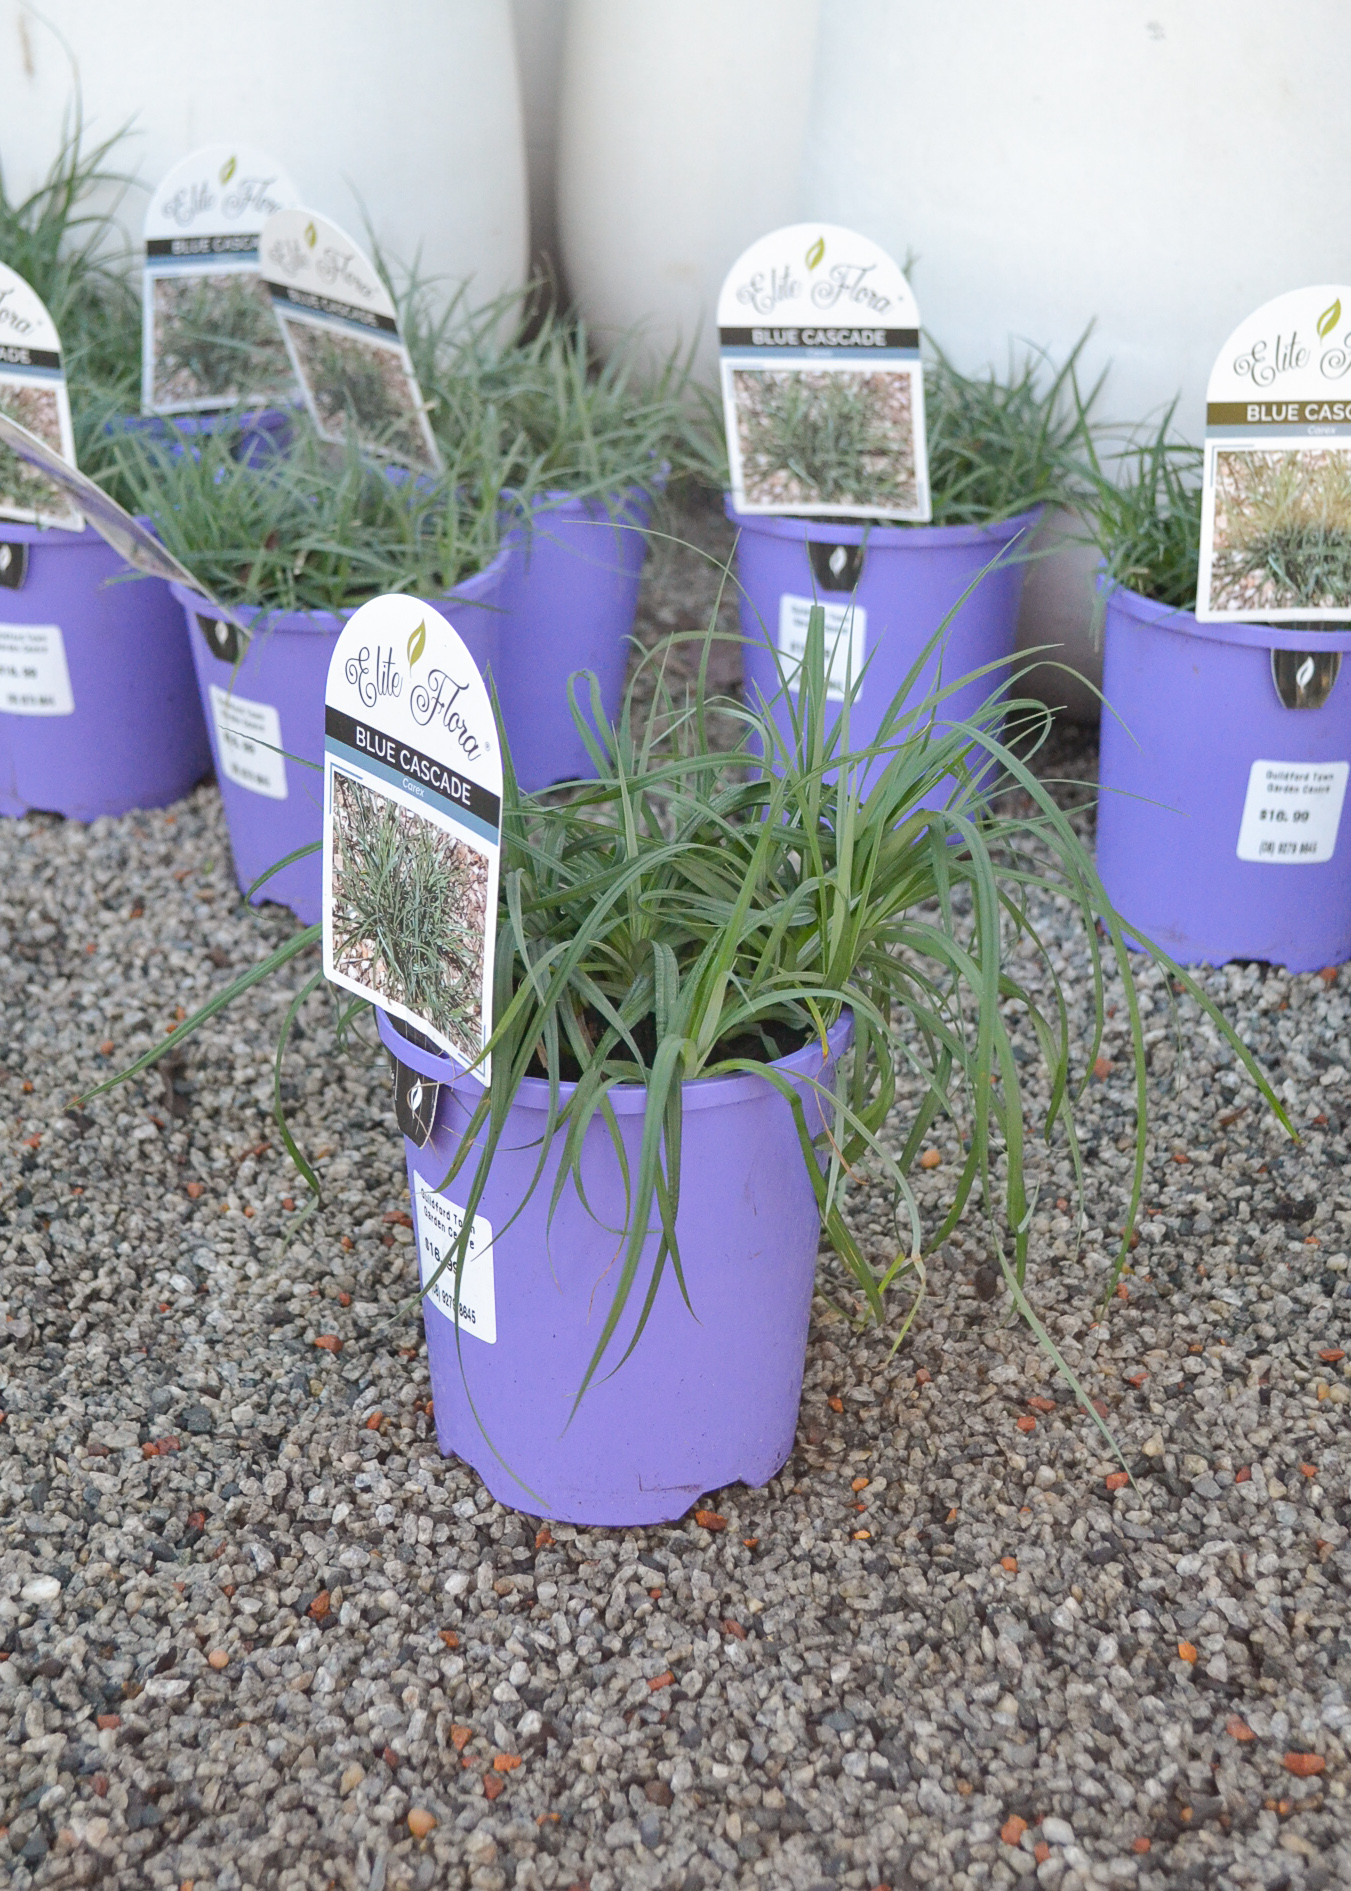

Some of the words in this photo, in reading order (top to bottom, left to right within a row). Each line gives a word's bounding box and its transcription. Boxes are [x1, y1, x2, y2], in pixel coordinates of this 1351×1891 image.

[171, 238, 211, 255] BLUE
[211, 234, 259, 253] CASCA
[736, 264, 800, 315] Elite
[811, 263, 892, 315] Flora
[751, 328, 800, 346] BLUE
[801, 328, 887, 347] CASCADE
[1233, 331, 1310, 388] Elite
[1247, 404, 1299, 421] BLUE
[345, 646, 403, 707] Elite
[410, 669, 481, 761] Flora
[356, 726, 396, 763] BLUE
[400, 749, 471, 806] CASCADE
[402, 778, 425, 798] Carex
[421, 1188, 451, 1221] Guildford
[453, 1213, 476, 1235] Ton
[424, 1205, 446, 1232] Garden
